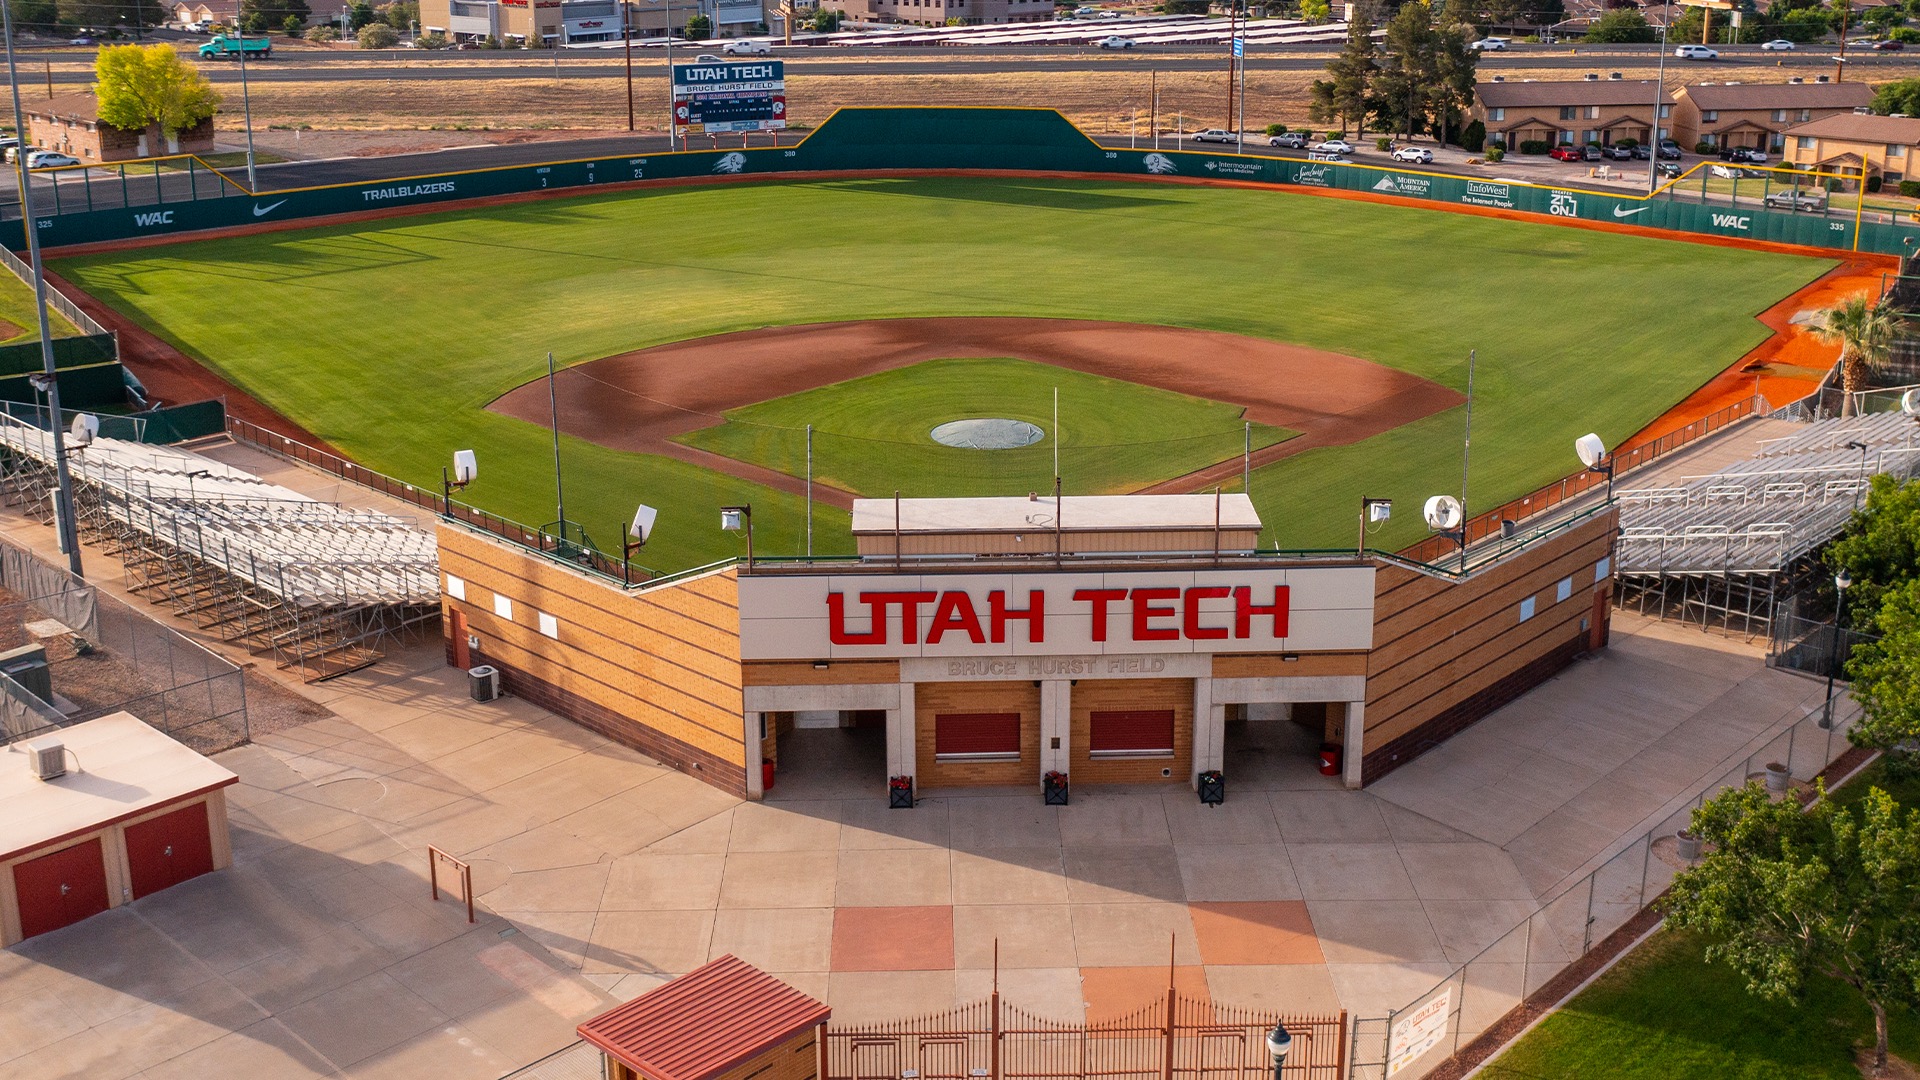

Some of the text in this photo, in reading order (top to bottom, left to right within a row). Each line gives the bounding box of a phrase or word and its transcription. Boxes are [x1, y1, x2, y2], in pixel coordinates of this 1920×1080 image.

[686, 65, 773, 81] UTAH TECH
[686, 82, 773, 93] BRUCE HURST FIELD
[1218, 161, 1262, 170] Intermountain
[588, 172, 594, 182] 9
[634, 168, 643, 179] 25
[541, 177, 547, 187] 3
[1397, 176, 1431, 187] MOUNTAIN
[1399, 183, 1427, 192] AMERICA
[362, 181, 455, 201] TRAILBLAZERS
[1469, 183, 1507, 196] InfoWest
[1461, 195, 1513, 208] The Internet People
[37, 220, 53, 229] 325
[134, 210, 174, 227] WAC
[1711, 213, 1750, 230] WAC
[1829, 222, 1845, 231] 335
[826, 585, 1290, 645] UTAH TECH
[947, 657, 1165, 677] BRUCE HURST FIELD
[1431, 997, 1447, 1010] TEC
